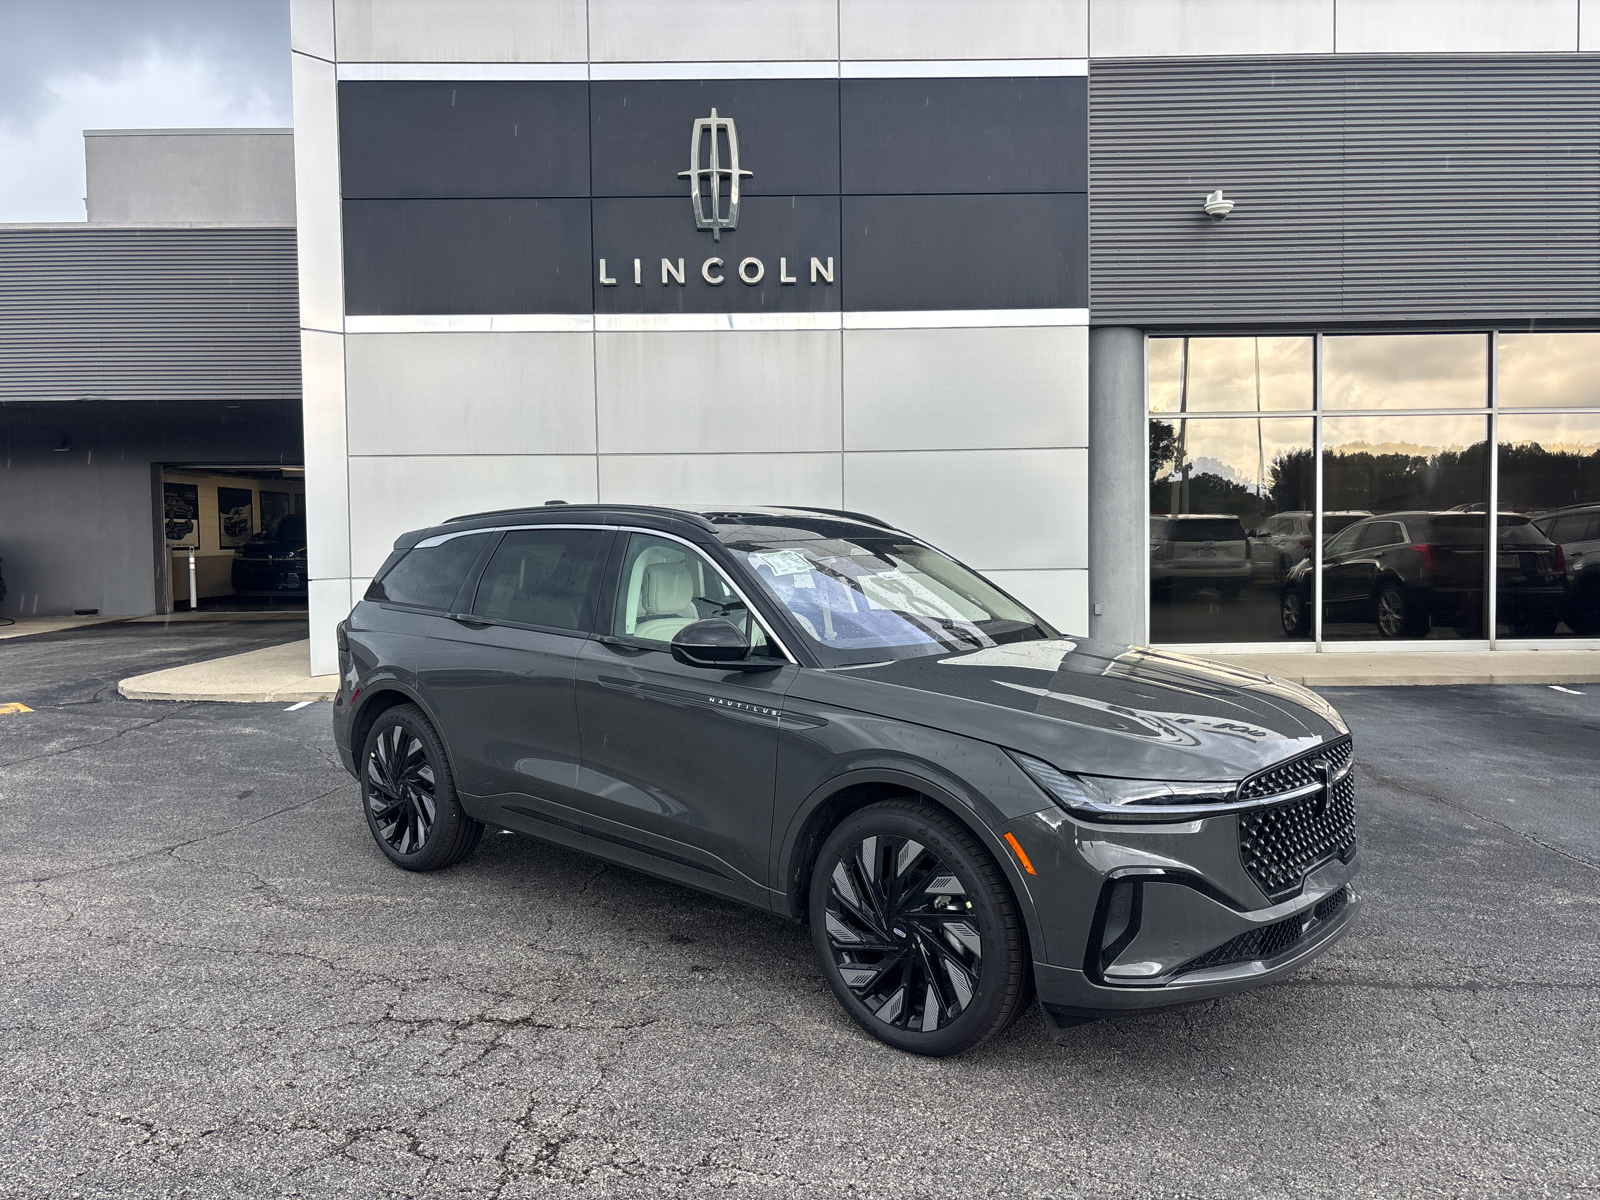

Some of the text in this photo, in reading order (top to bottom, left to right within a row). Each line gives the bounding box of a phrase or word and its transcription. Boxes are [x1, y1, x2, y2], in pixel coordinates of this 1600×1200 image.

[599, 256, 835, 286] LINCOLN
[708, 696, 778, 716] NAUTILUS
[916, 827, 995, 951] GOODYEAR
